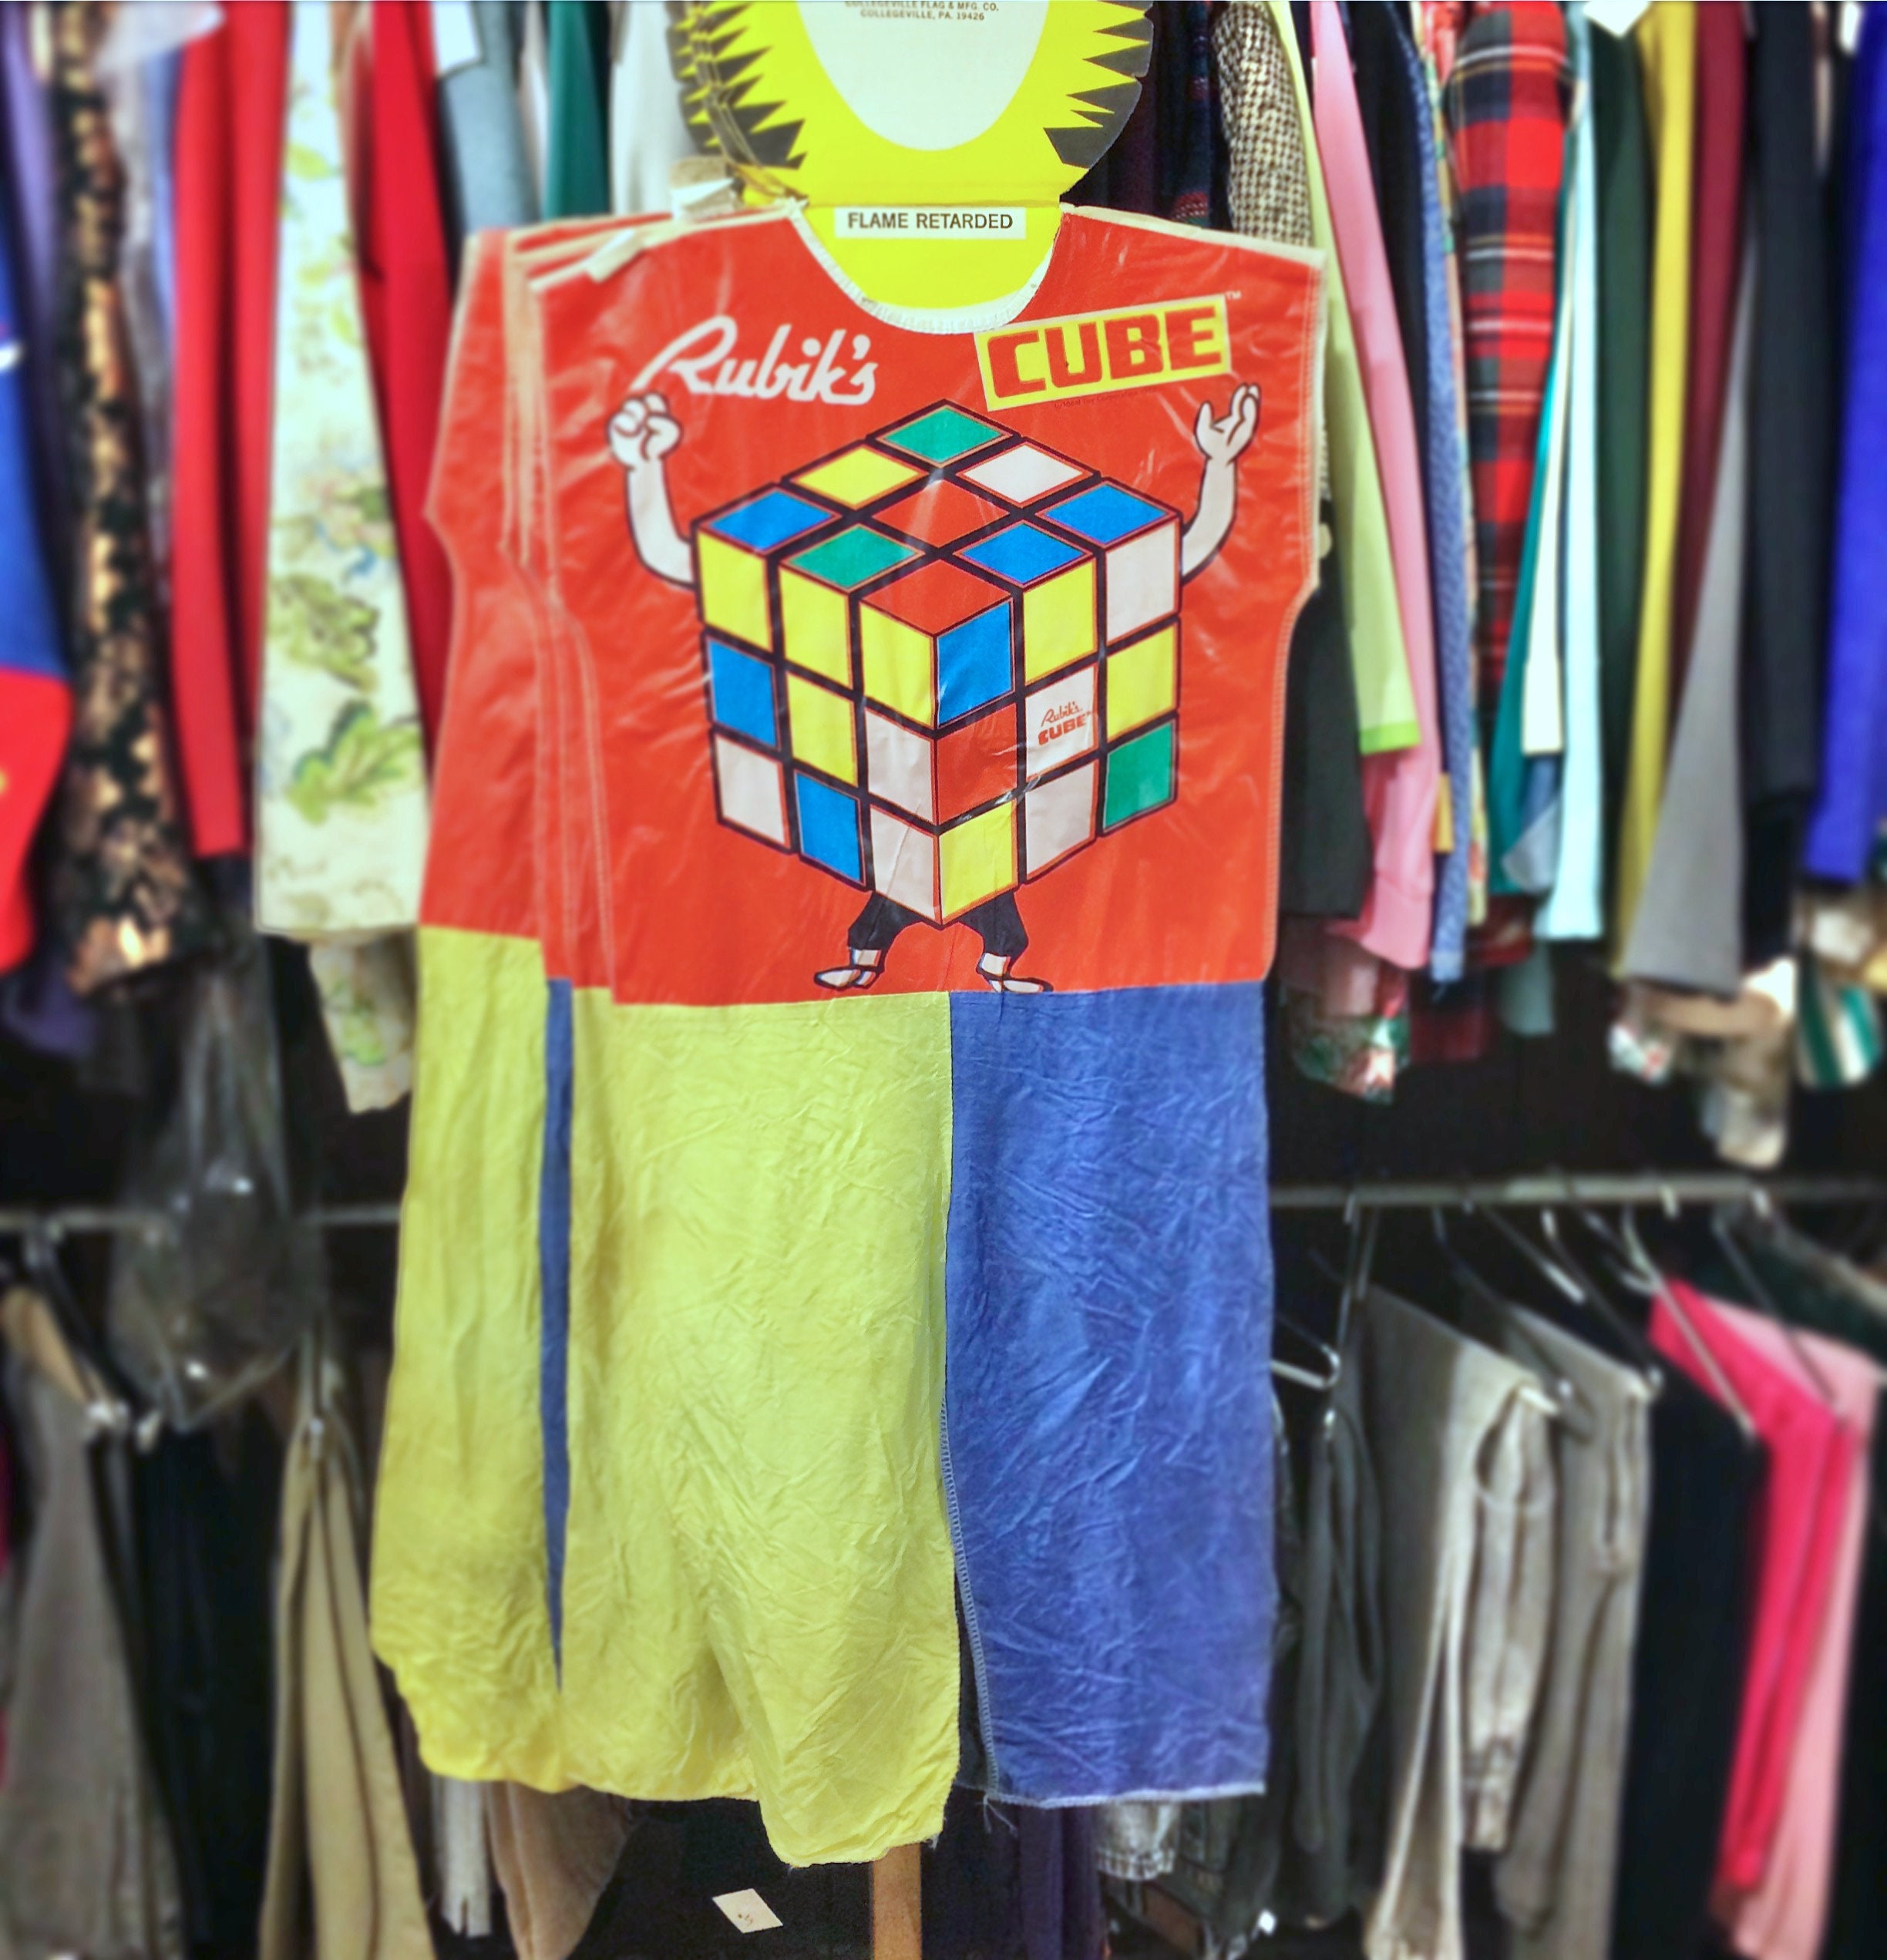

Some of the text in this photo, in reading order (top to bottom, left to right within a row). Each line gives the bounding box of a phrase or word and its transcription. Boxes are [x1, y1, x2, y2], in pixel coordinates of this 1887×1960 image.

[860, 9, 936, 20] COLLEGEVILLE,
[957, 12, 984, 21] 19426
[920, 1, 945, 9] FLAG
[983, 2, 999, 12] CO.
[848, 212, 1013, 230] FLAME RETARDED
[629, 305, 1223, 405] Rubik's CUBE
[1041, 701, 1083, 727] Rubik's
[1038, 713, 1086, 745] CUBE
